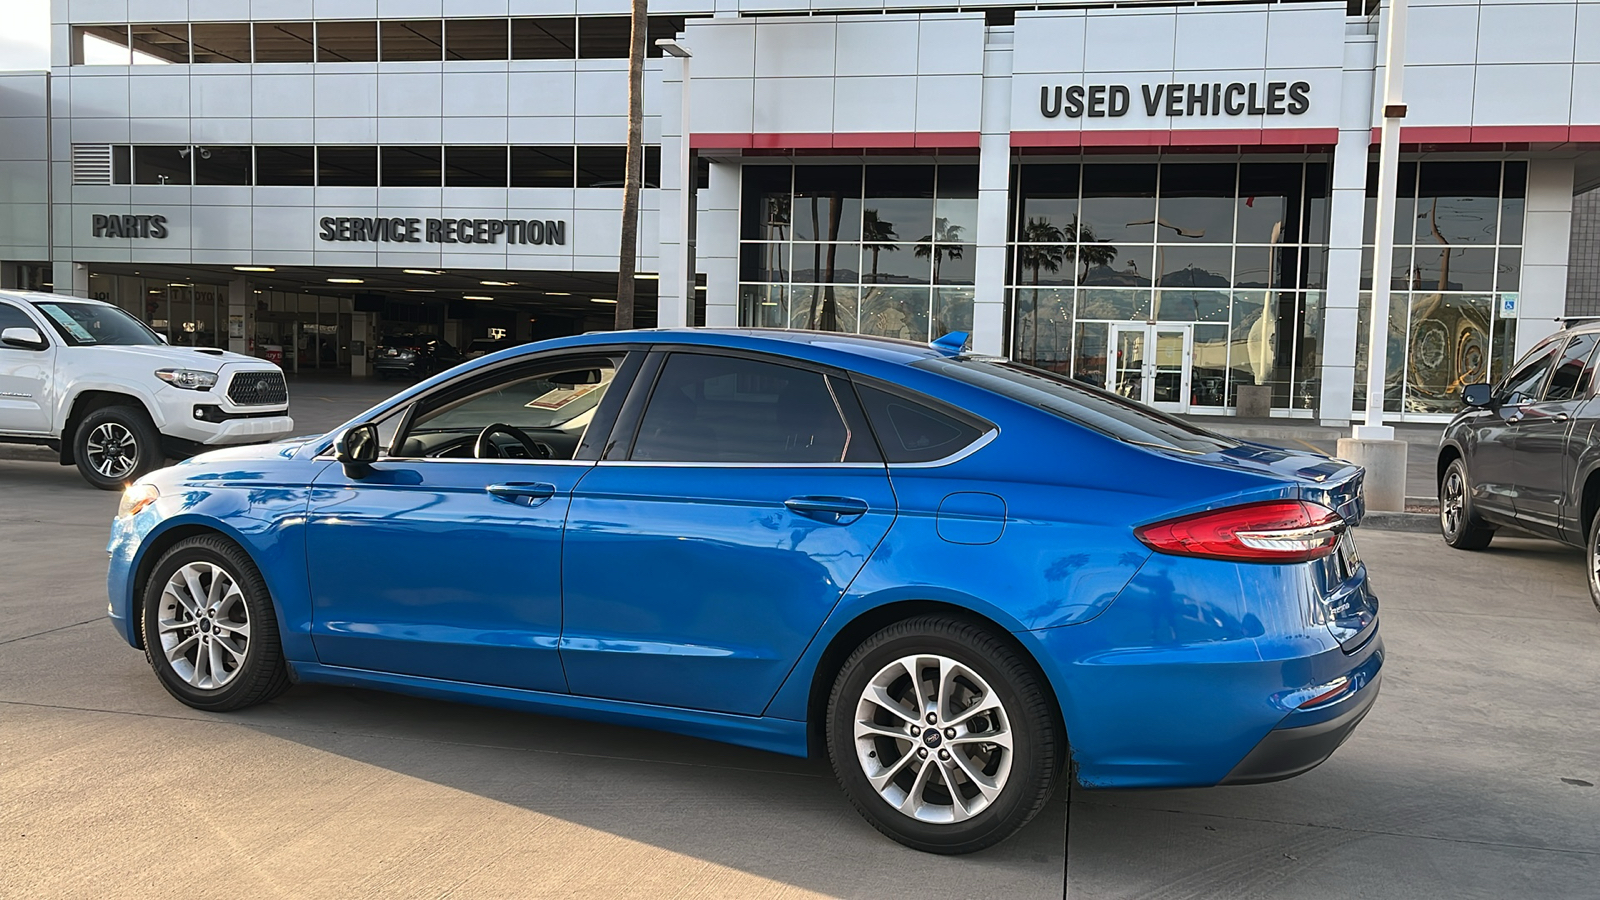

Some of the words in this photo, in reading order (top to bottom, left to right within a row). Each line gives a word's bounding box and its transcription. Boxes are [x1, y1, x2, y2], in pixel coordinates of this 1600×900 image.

[1040, 85, 1130, 118] USED
[1141, 81, 1311, 117] VEHICLES
[92, 214, 168, 239] PARTS
[319, 217, 421, 243] SERVICE
[425, 218, 566, 246] RECEPTION
